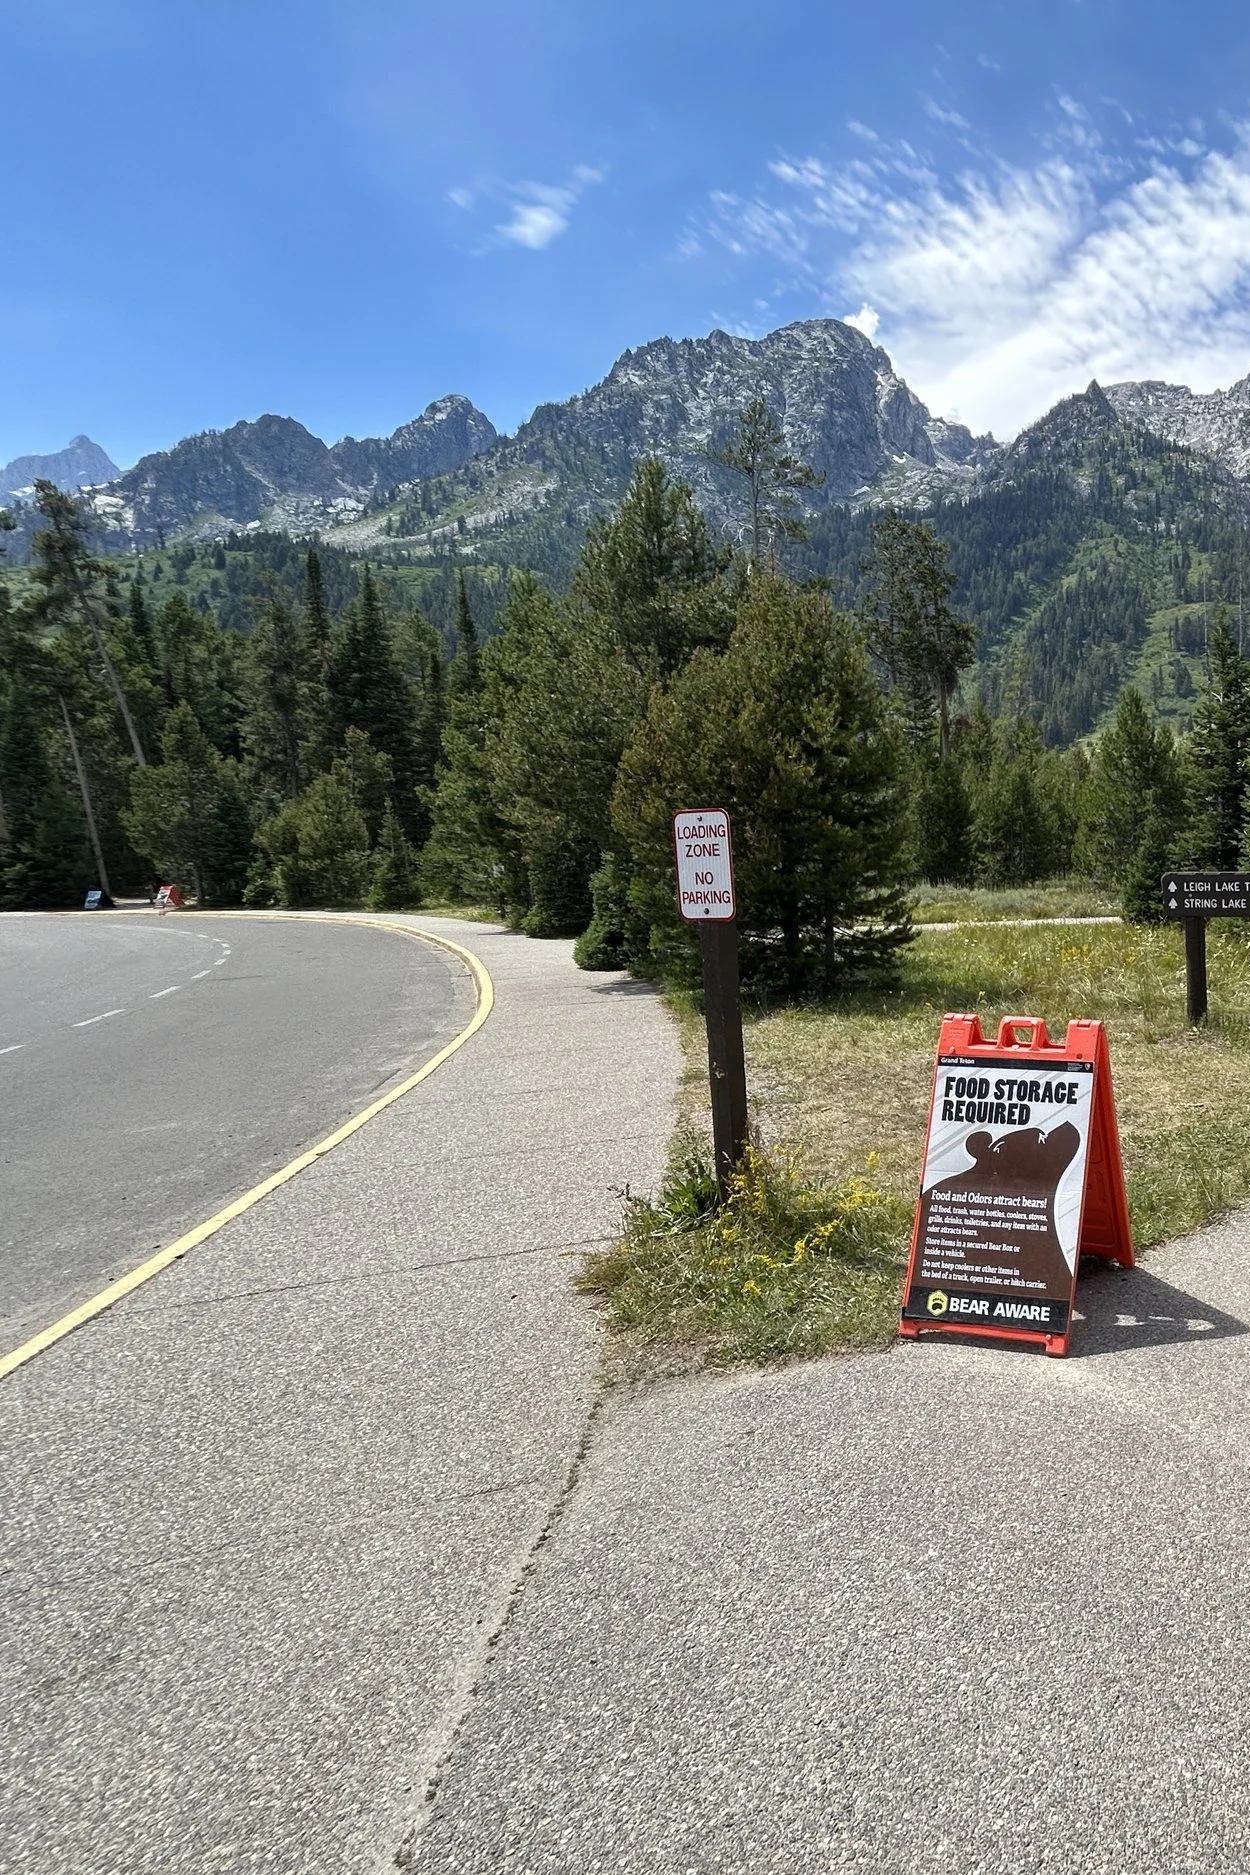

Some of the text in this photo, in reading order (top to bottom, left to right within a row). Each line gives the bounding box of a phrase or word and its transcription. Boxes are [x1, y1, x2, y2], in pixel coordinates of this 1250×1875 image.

[677, 824, 726, 839] LOADING
[685, 843, 720, 857] ZONE
[695, 872, 713, 885] NO
[1184, 882, 1211, 892] LEIGH
[1216, 882, 1240, 892] LAKE
[682, 891, 730, 904] PARKING
[1184, 899, 1247, 909] STRING LAKE
[944, 1076, 1078, 1104] FOOD STORAGE
[941, 1100, 1031, 1125] REQUIRED
[931, 1190, 1047, 1208] Food and Odors attract bears!
[930, 1205, 938, 1213] All
[926, 1237, 940, 1245] Store
[956, 1239, 962, 1247] in
[989, 1242, 1002, 1251] Bear
[923, 1259, 931, 1267] Do
[941, 1261, 954, 1270] keep
[931, 1270, 941, 1278] bed
[942, 1271, 948, 1279] of
[970, 1275, 983, 1284] open
[949, 1297, 1050, 1321] BEAR AWARE
